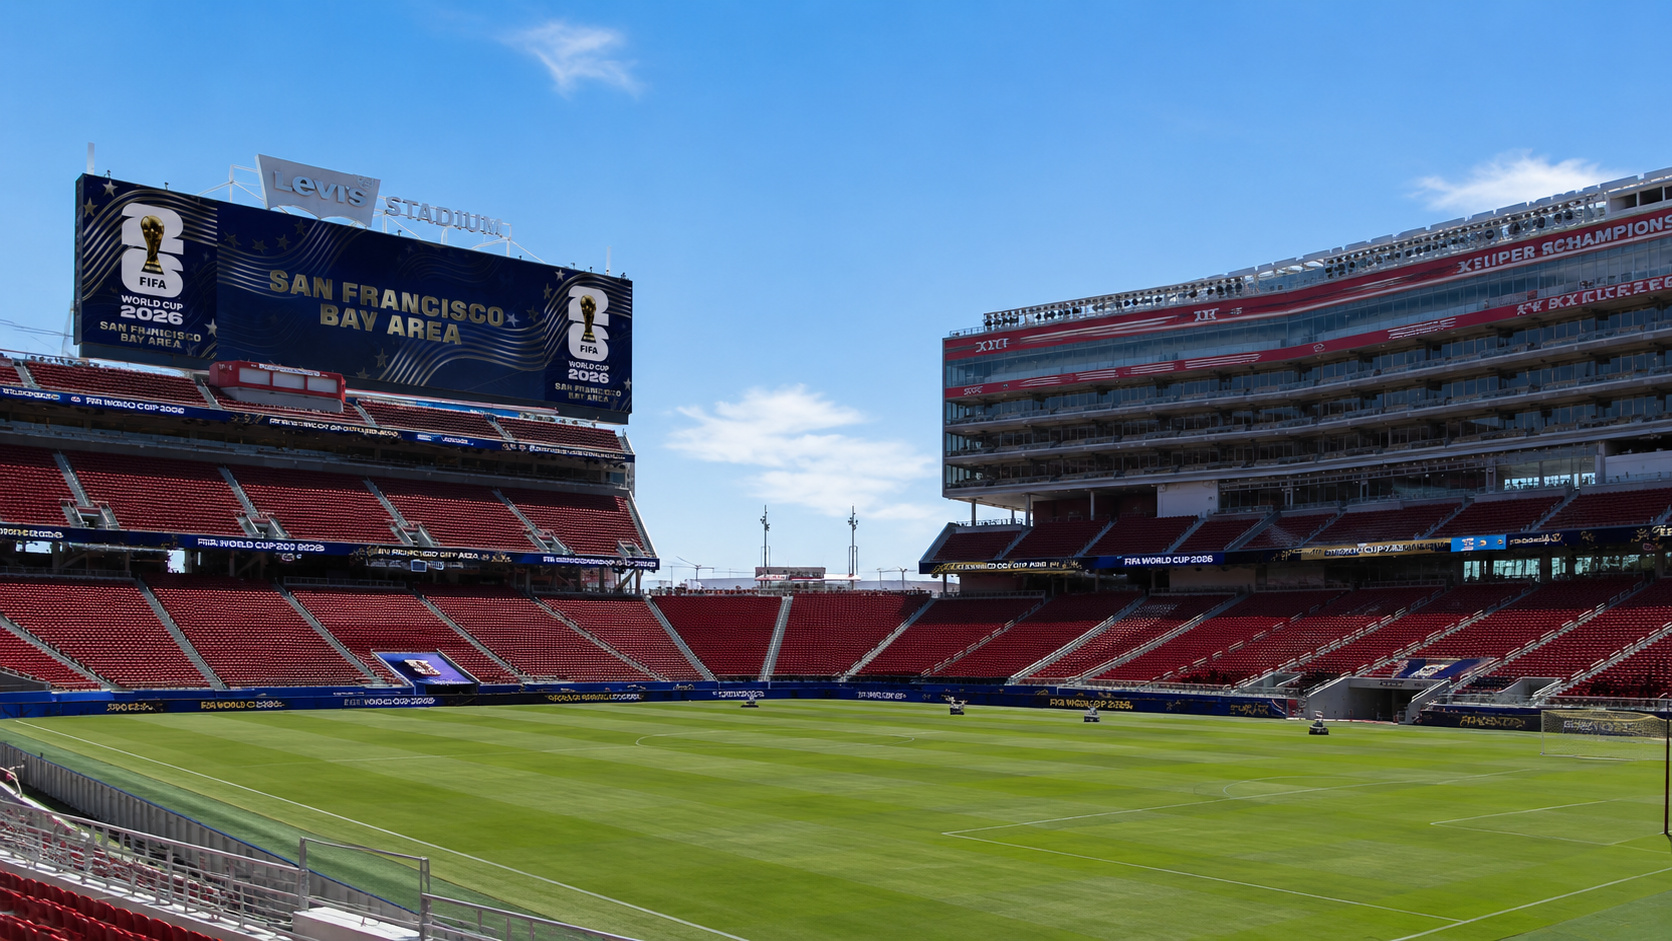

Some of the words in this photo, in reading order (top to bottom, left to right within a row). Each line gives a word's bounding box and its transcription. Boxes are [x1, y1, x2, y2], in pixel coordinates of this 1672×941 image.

[385, 196, 503, 238] STADIUM
[139, 277, 166, 289] FIFA
[121, 294, 160, 307] WORLD
[162, 301, 182, 310] CUP
[269, 269, 333, 300] SAN
[342, 281, 504, 328] FRANCISCO
[120, 304, 183, 325] 2026
[100, 321, 126, 331] SAN
[320, 303, 378, 332] BAY
[387, 314, 462, 345] AREA
[120, 333, 144, 344] BAY
[580, 345, 598, 354] FIFA
[568, 360, 595, 370] WORLD
[568, 368, 609, 384] 2026
[1141, 556, 1171, 565] WORLD
[1172, 555, 1190, 564] CUP
